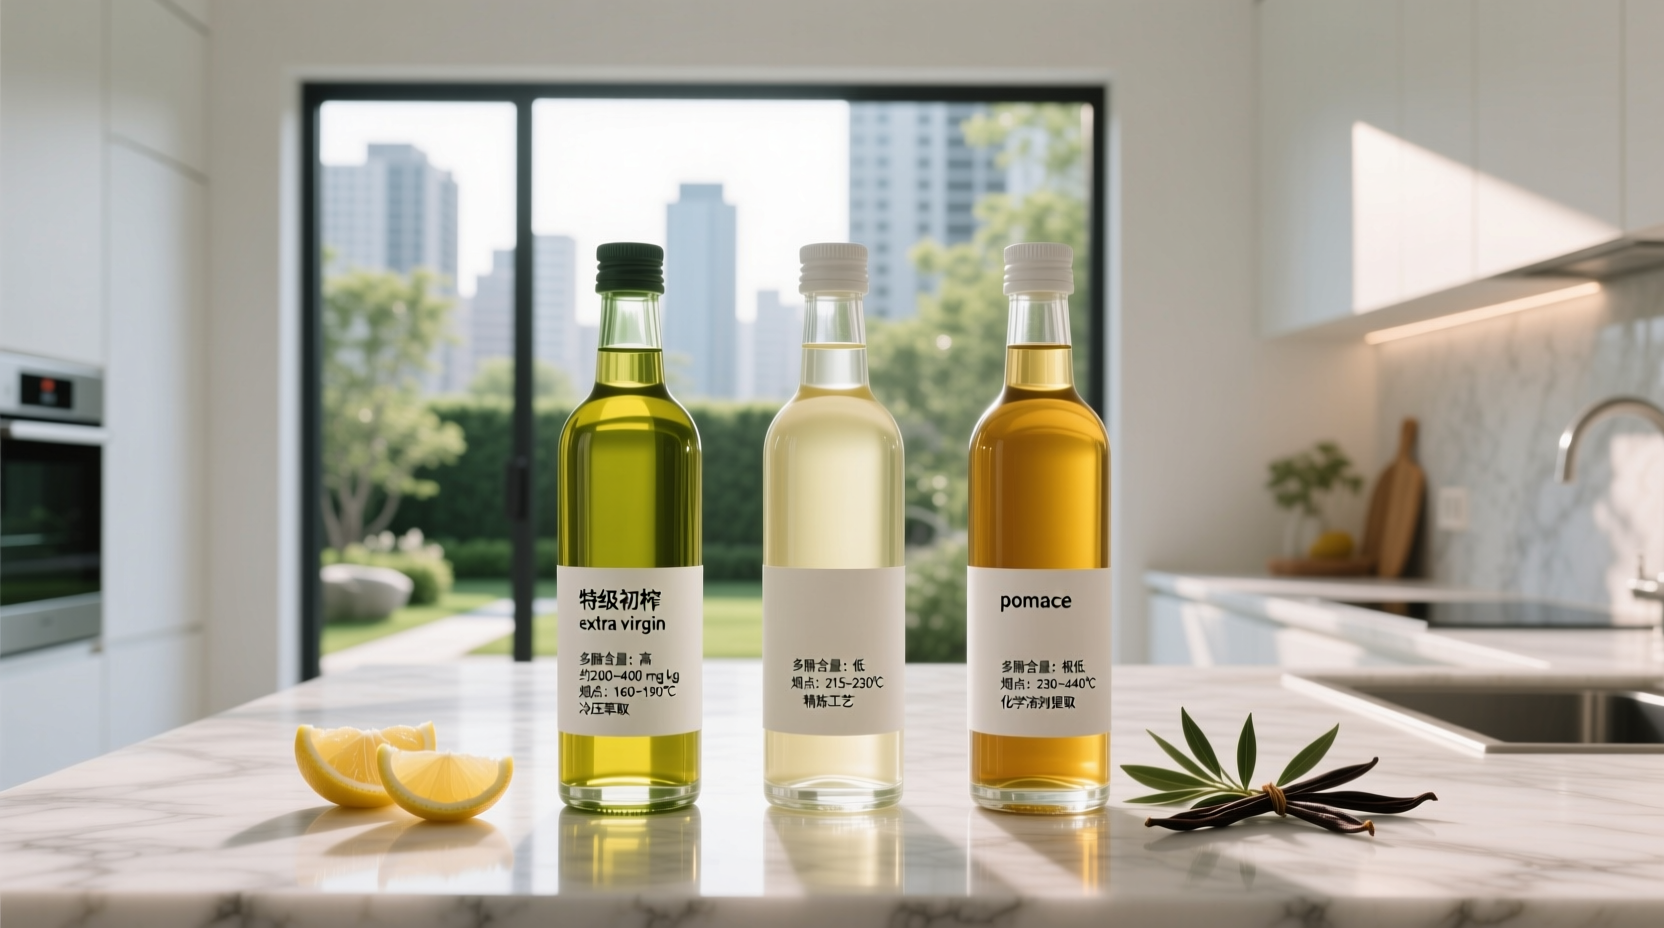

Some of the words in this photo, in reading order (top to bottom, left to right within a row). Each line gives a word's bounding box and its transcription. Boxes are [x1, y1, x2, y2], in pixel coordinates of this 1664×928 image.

[579, 588, 661, 611] 特级初榨
[1001, 595, 1072, 612] pomace
[580, 616, 617, 631] extra
[621, 616, 665, 634] virgin
